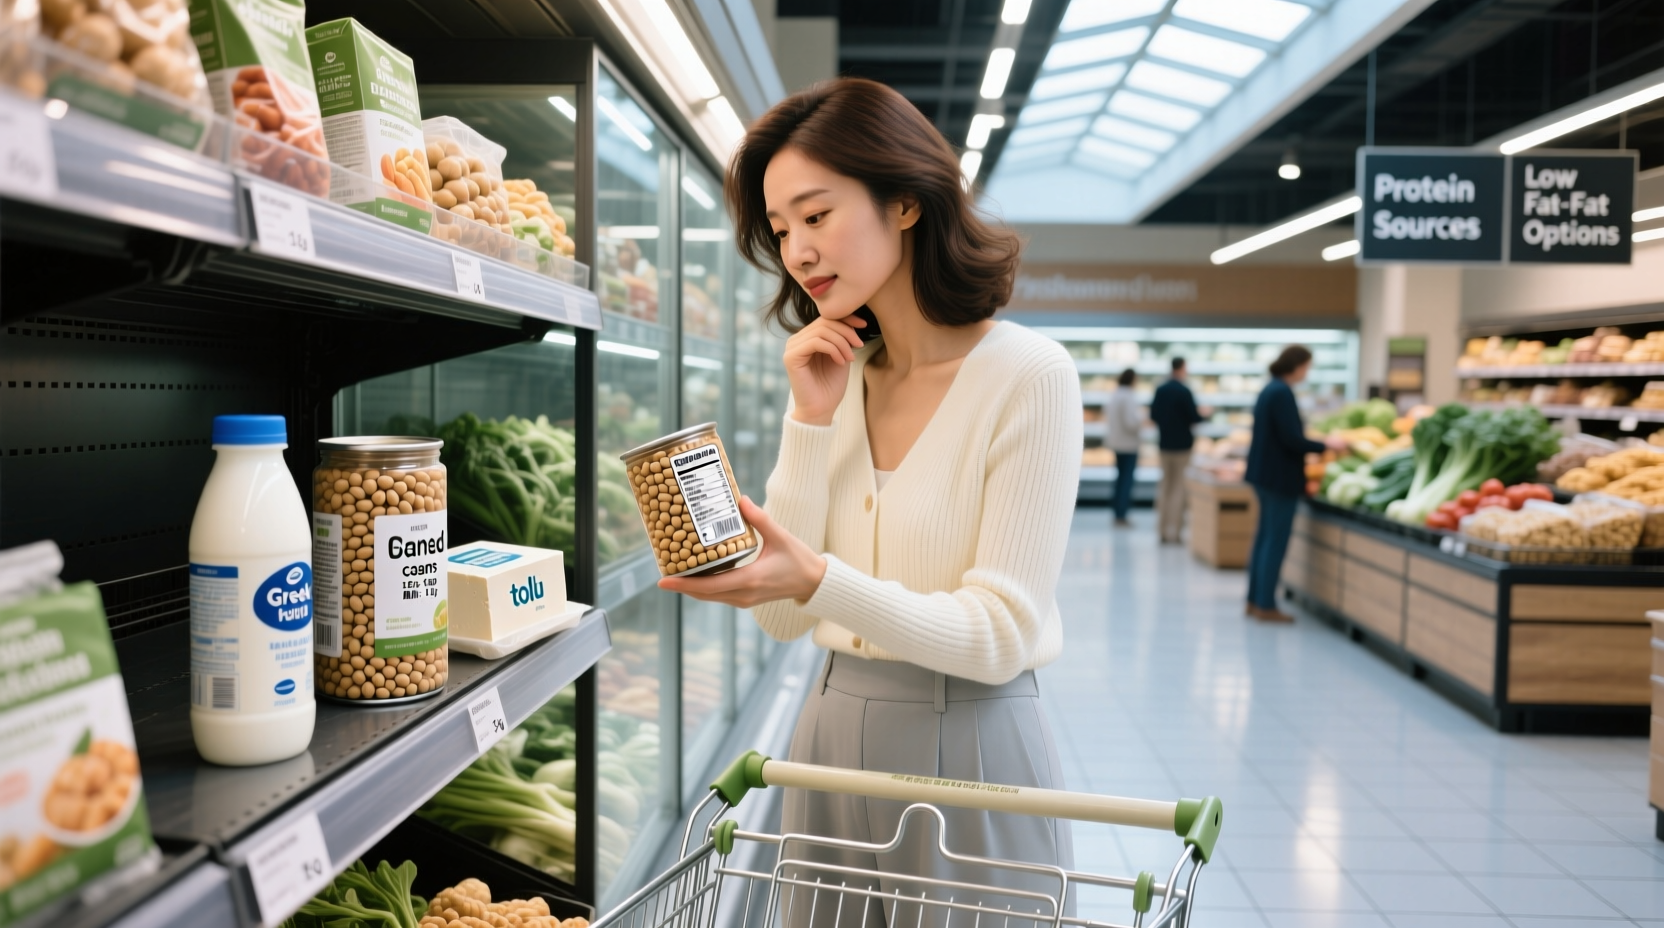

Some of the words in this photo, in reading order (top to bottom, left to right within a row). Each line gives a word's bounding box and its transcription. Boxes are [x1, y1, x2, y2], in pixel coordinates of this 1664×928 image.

[1373, 172, 1476, 203] Protein
[1524, 163, 1578, 189] Low
[1523, 190, 1611, 217] Fat-Fat
[1372, 209, 1482, 241] Sources
[1522, 218, 1621, 252] Options
